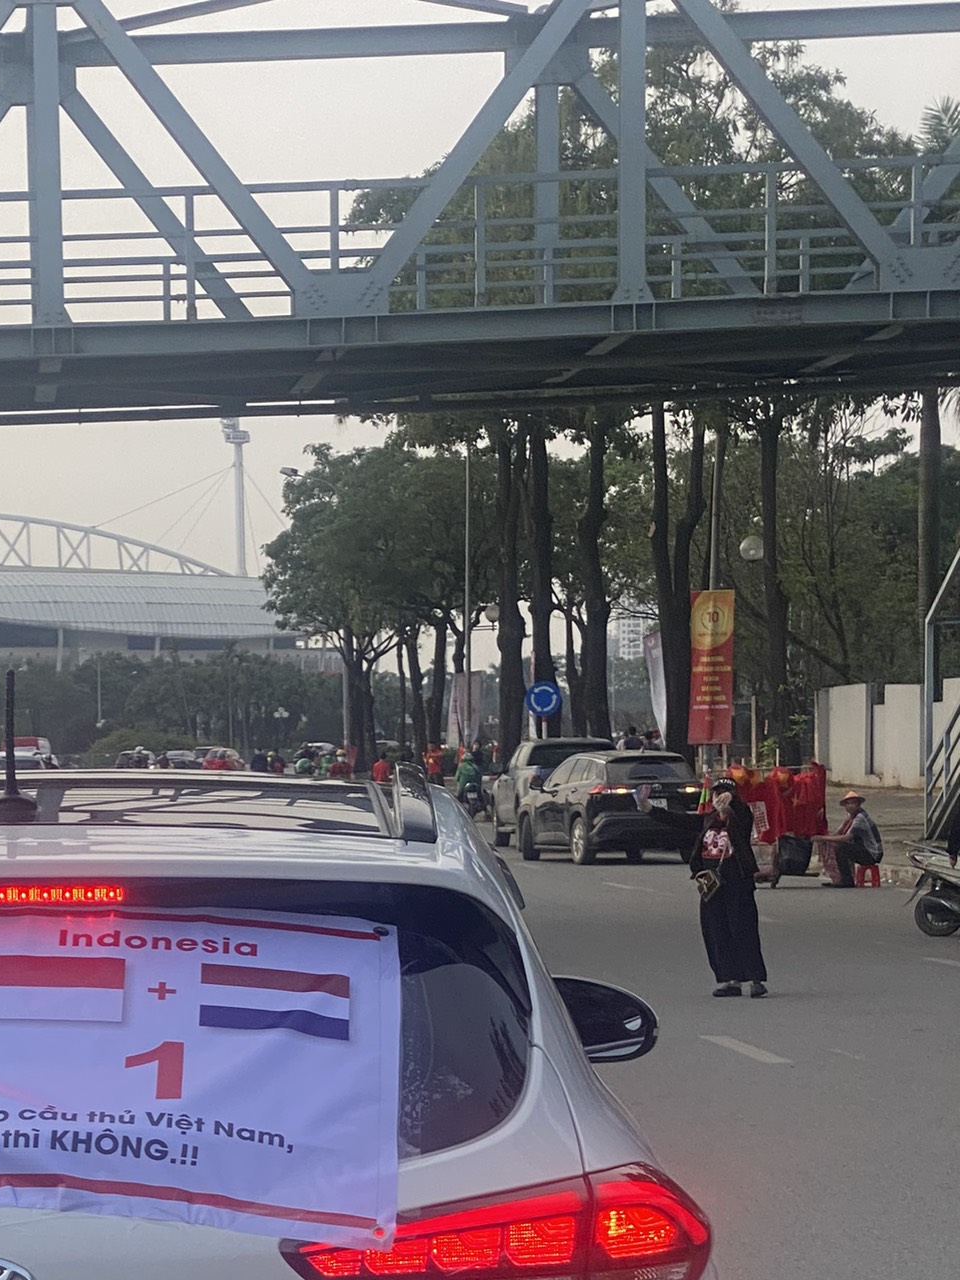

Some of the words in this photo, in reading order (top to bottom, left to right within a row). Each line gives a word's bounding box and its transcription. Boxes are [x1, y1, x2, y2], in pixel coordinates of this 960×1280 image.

[706, 611, 719, 623] 10
[58, 929, 258, 957] Indonesia
[125, 1041, 185, 1100] 1
[1, 1128, 40, 1149] thì
[50, 1128, 199, 1166] KHÔNG.!!
[18, 1105, 78, 1122] cầu
[87, 1110, 136, 1125] thủ
[145, 1112, 206, 1136] Việt
[213, 1120, 294, 1154] Nam,
